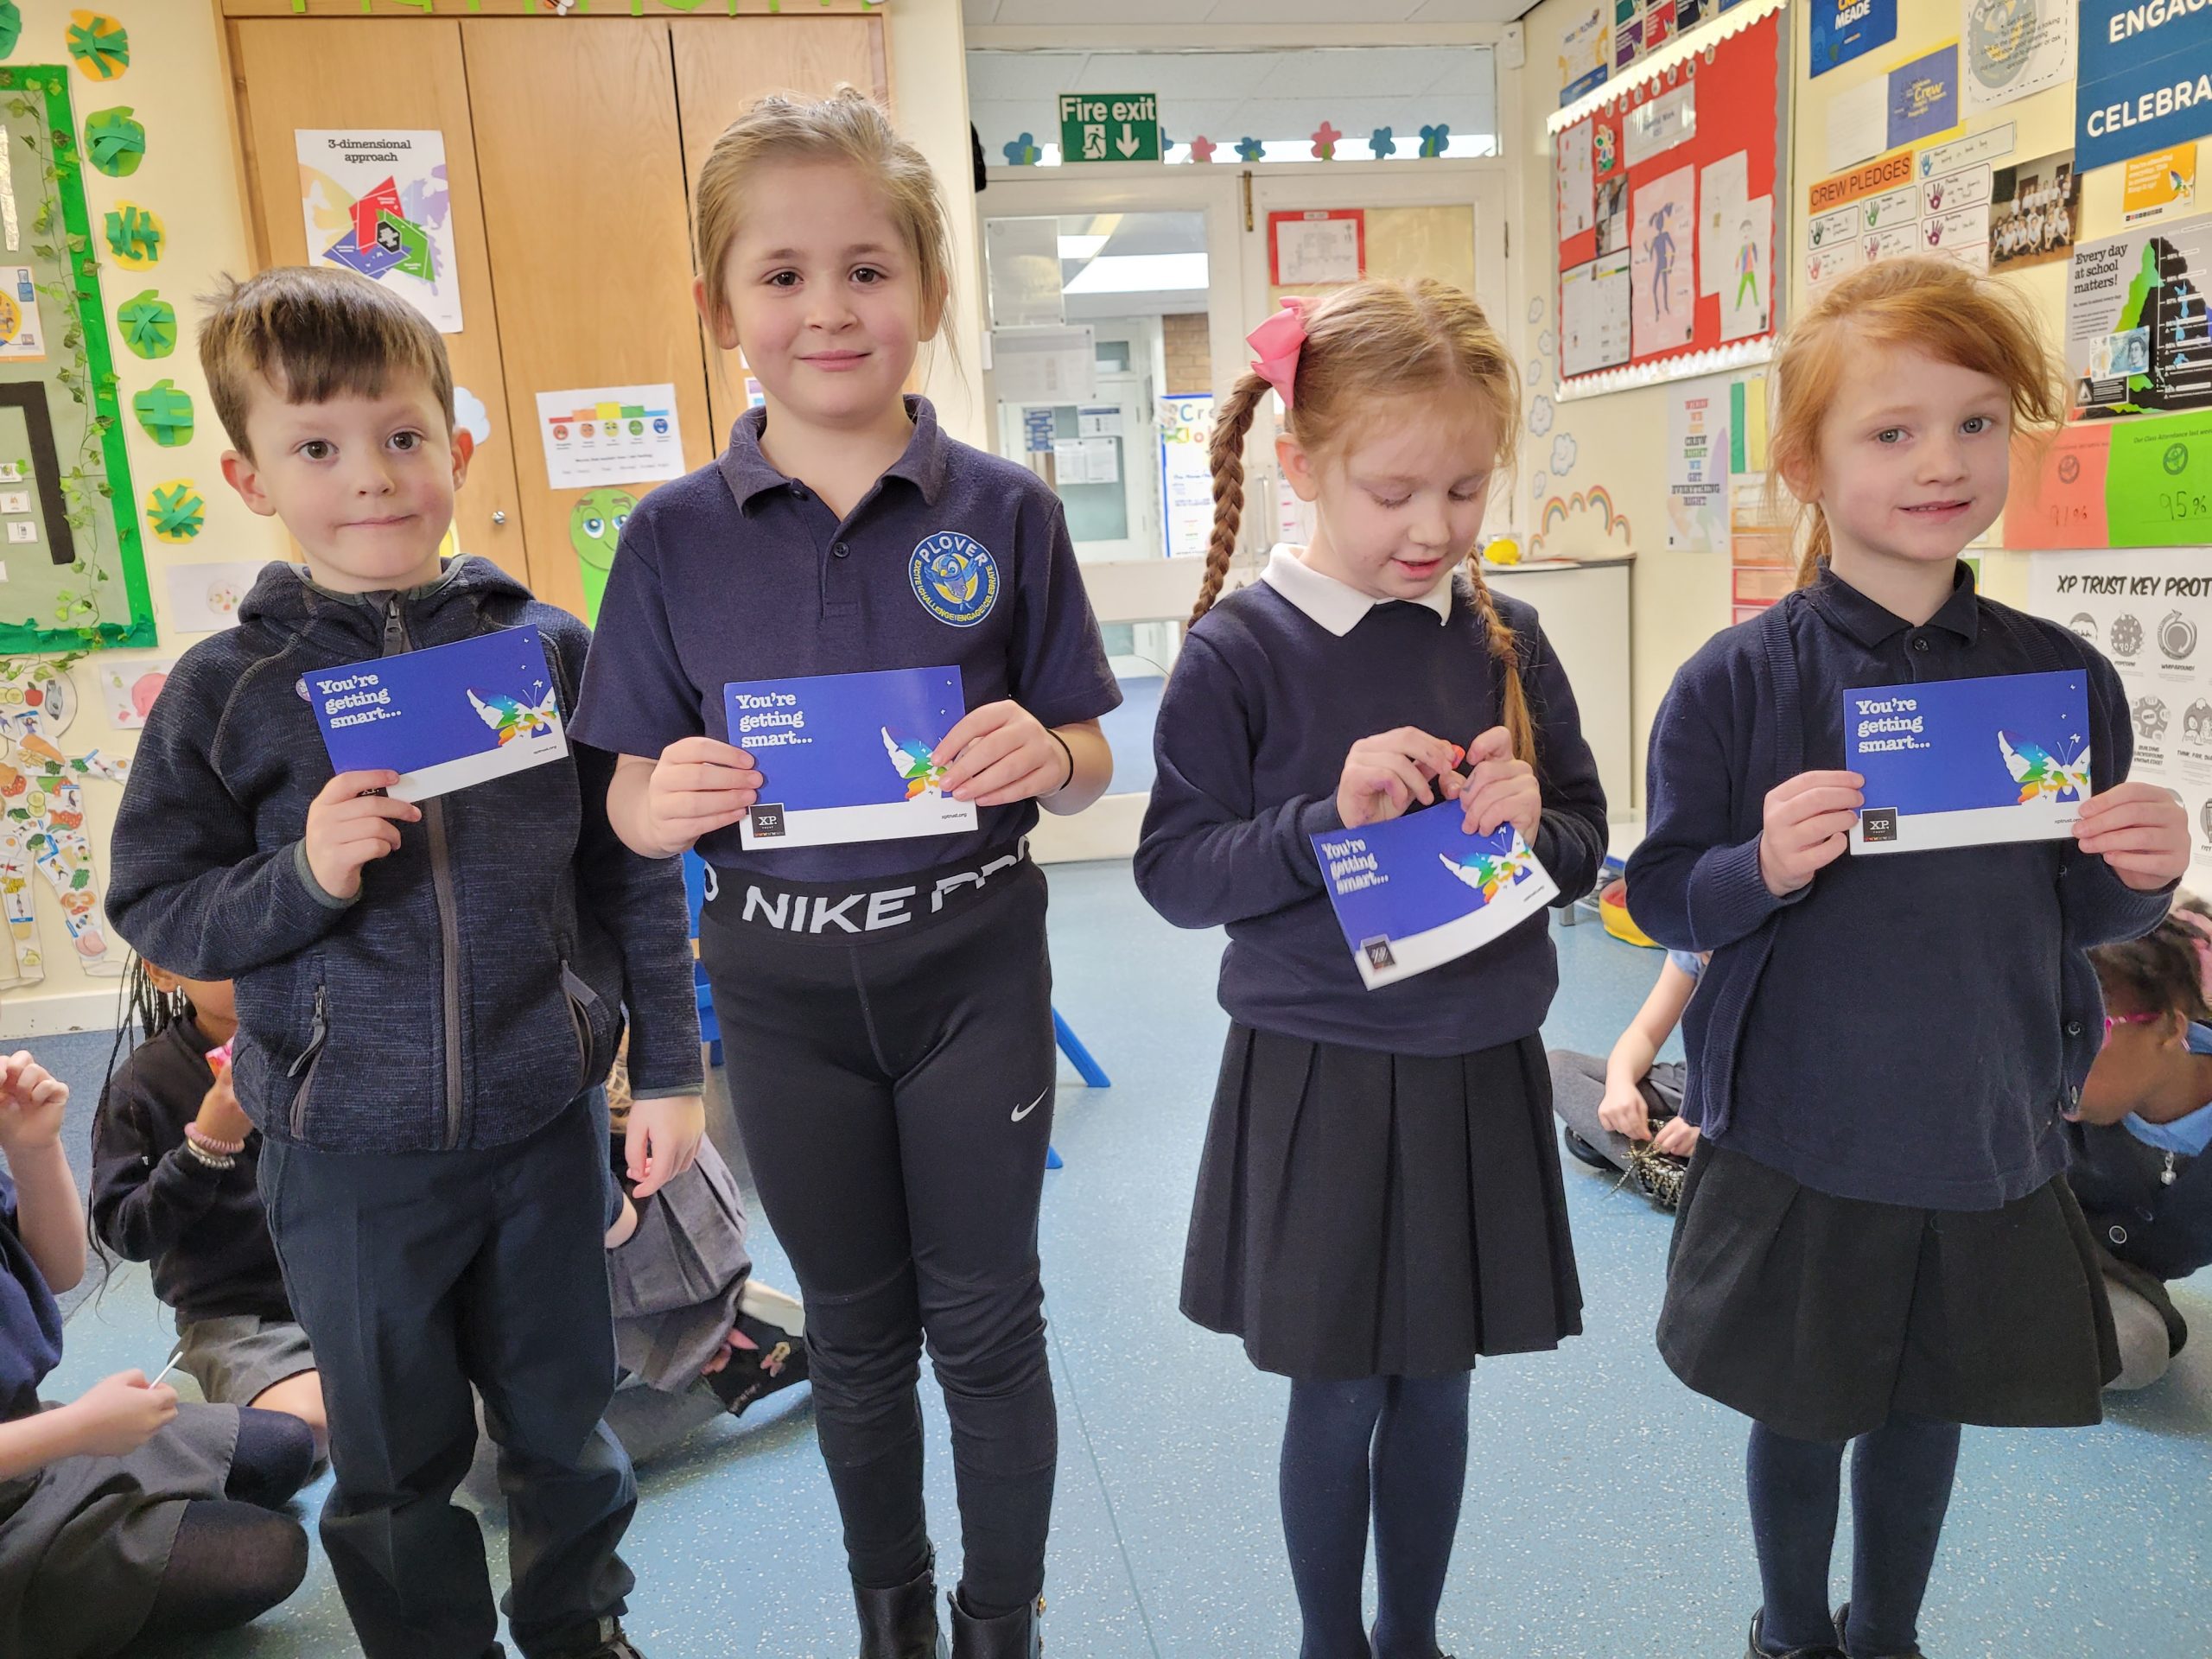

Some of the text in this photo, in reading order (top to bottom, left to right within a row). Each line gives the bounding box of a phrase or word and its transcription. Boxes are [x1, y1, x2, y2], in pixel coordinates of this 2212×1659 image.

[1835, 1, 1871, 30] MEADE
[2109, 0, 2212, 43] ENGA
[1914, 81, 1944, 102] Crew
[1060, 96, 1156, 122] Fire exit
[2087, 74, 2212, 137] CELEBRA
[328, 139, 412, 149] 3-dimensional
[345, 152, 398, 163] approach
[1810, 184, 1846, 207] CREW
[1850, 156, 1911, 192] PLEDGES
[2075, 244, 2128, 265] Every day
[2075, 259, 2119, 280] at school
[2074, 274, 2118, 294] matters!
[1685, 435, 1707, 446] CREW
[1684, 448, 1708, 458] RIGHT
[1671, 484, 1720, 494] EVERYTHING
[1683, 496, 1707, 506] RIGHT
[918, 536, 988, 567] PLOVER
[2056, 575, 2078, 594] XP
[2082, 575, 2127, 595] TRUST
[2130, 576, 2161, 596] KEY
[918, 586, 955, 620] CHALLENGE
[957, 607, 985, 621] ENGAGE
[316, 672, 379, 695] You're
[325, 688, 391, 715] getting
[735, 692, 797, 710] You're
[1856, 697, 1916, 715] You're
[330, 707, 402, 729] smart...
[739, 710, 804, 733] getting
[1858, 715, 1923, 738] getting
[741, 731, 812, 748] smart...
[1858, 735, 1930, 753] smart...
[742, 885, 917, 934] NIKE
